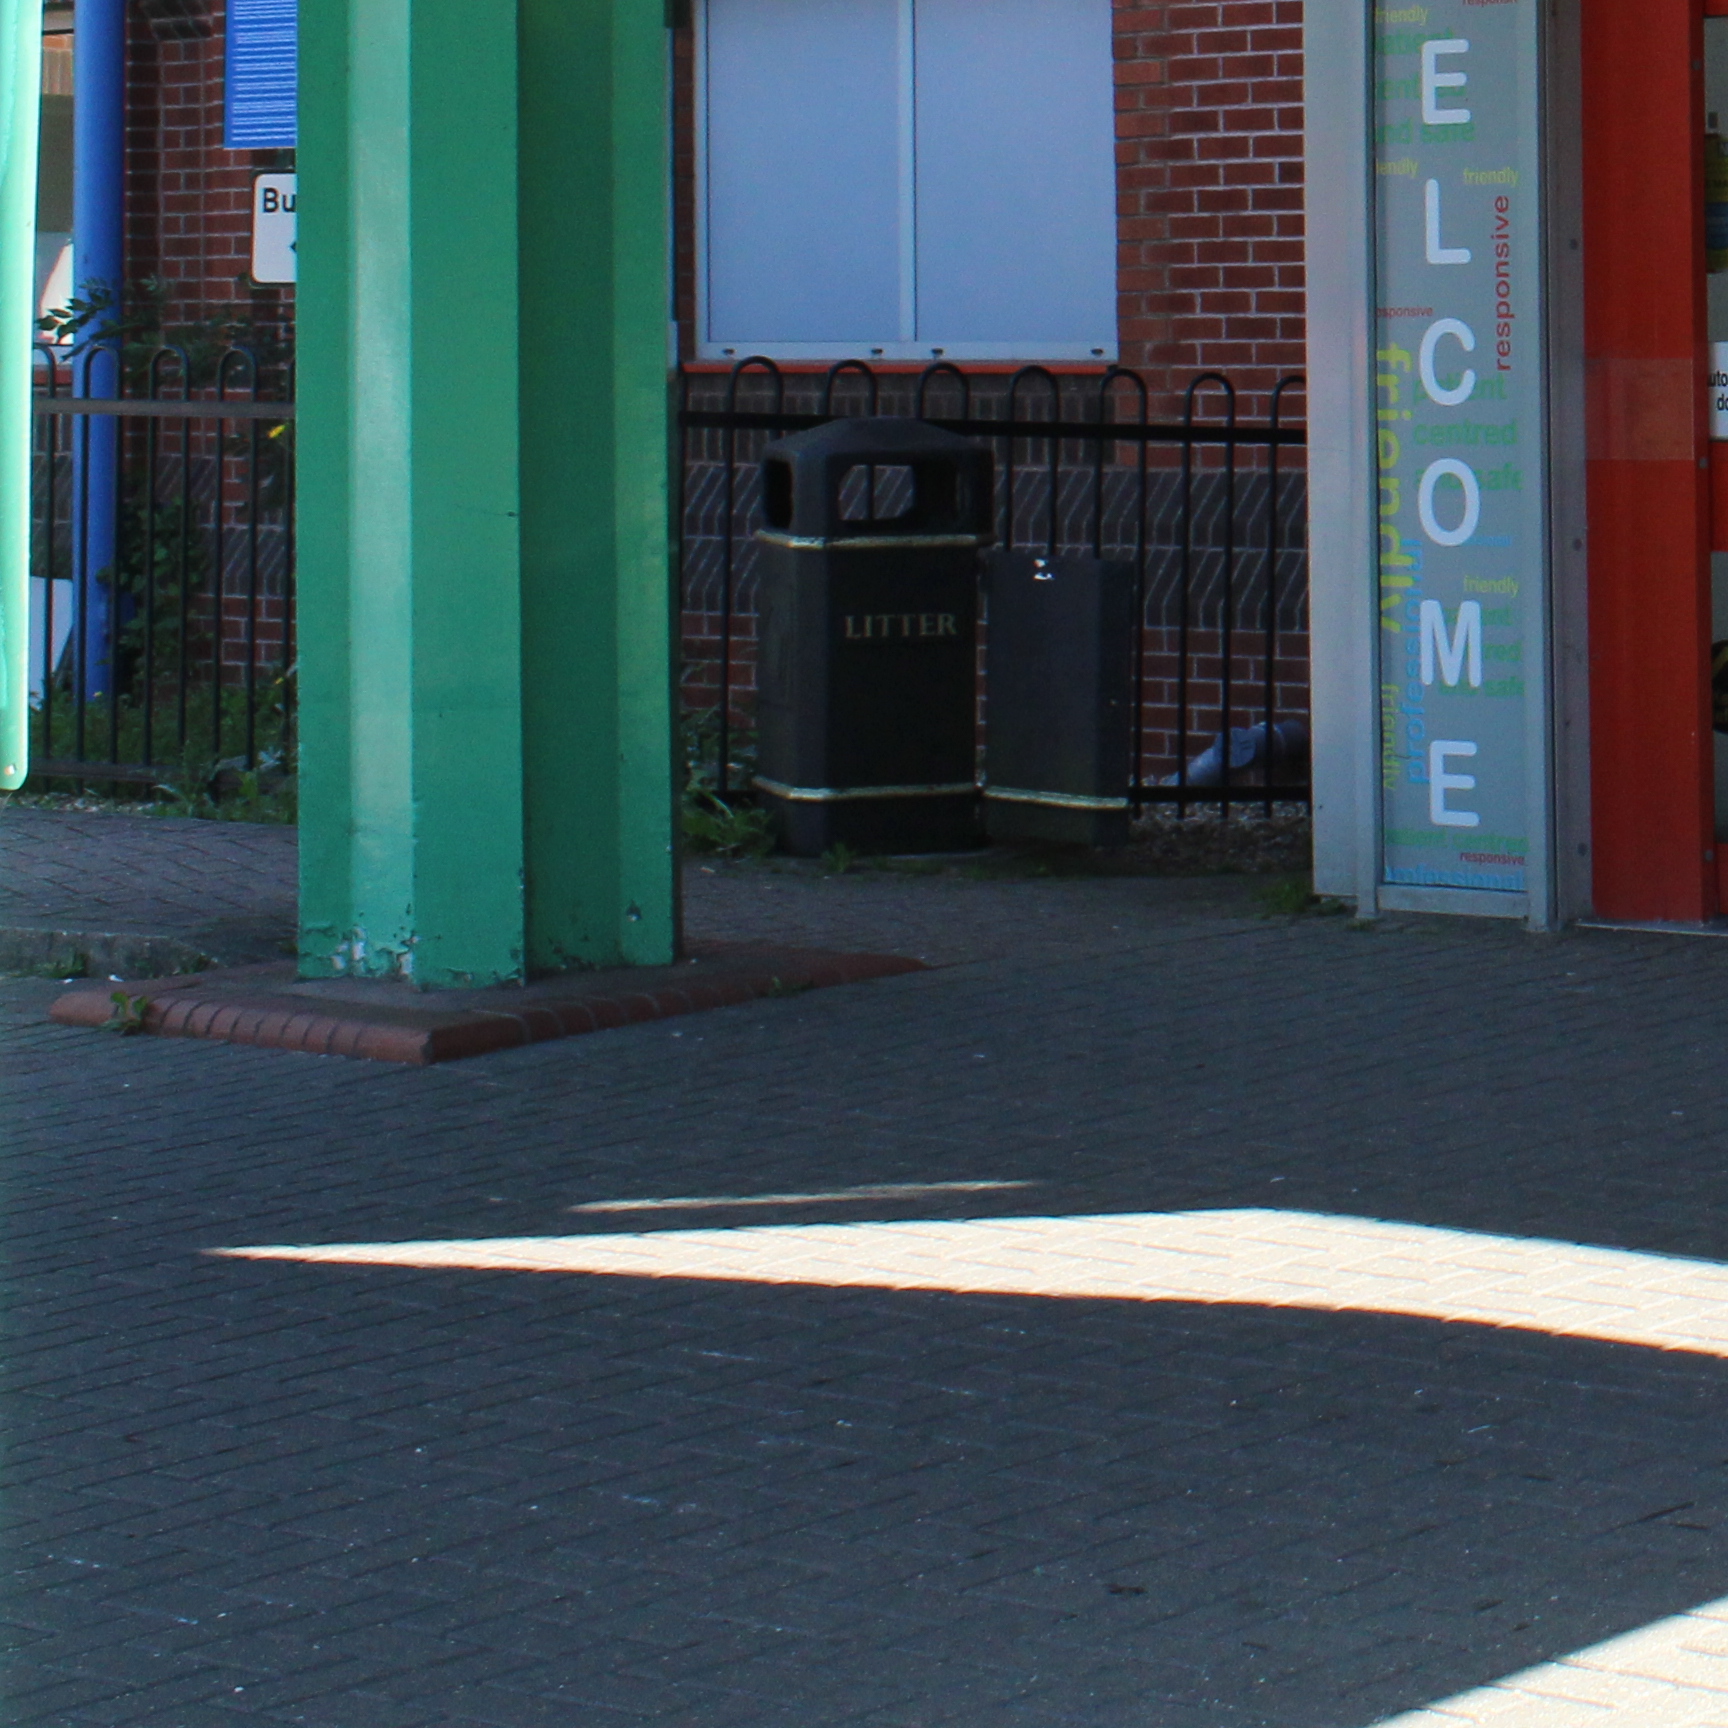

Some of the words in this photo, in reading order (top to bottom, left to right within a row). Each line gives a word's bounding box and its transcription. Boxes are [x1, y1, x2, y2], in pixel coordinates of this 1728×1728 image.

[1490, 195, 1516, 371] responsive
[1463, 575, 1519, 598] friendly
[844, 613, 957, 639] LITTER
